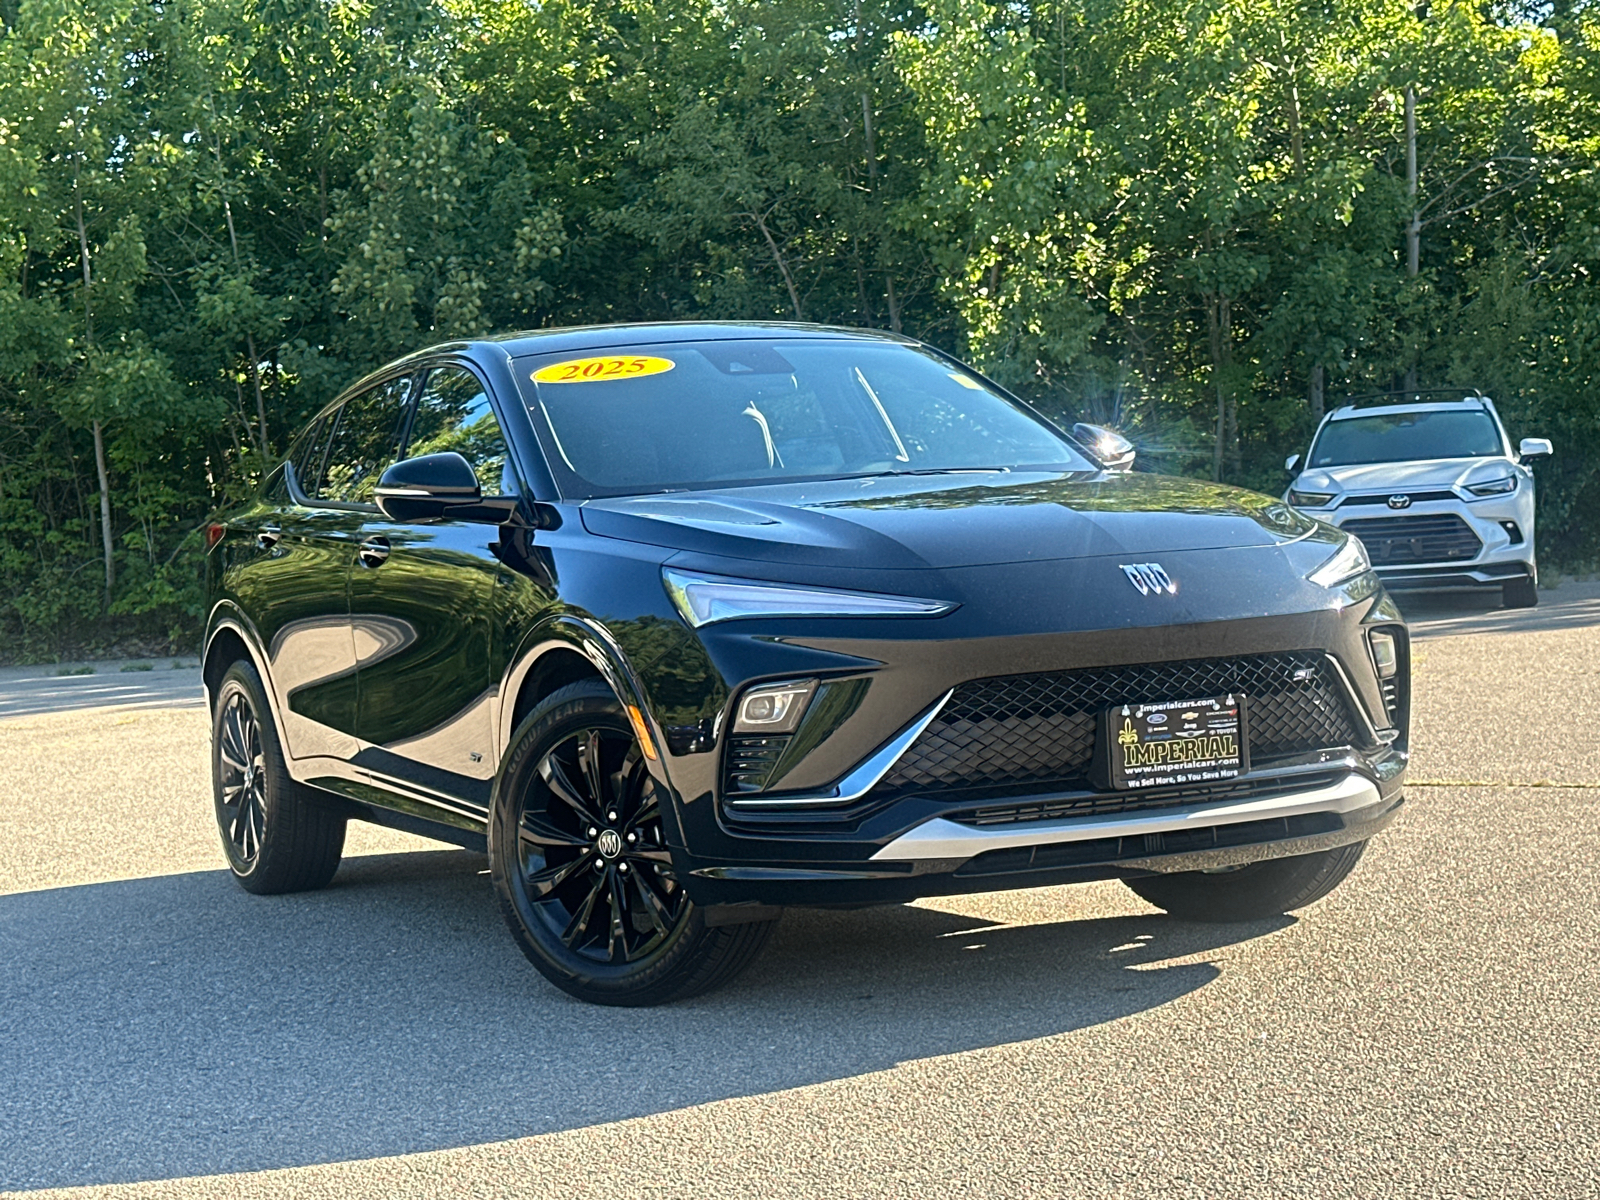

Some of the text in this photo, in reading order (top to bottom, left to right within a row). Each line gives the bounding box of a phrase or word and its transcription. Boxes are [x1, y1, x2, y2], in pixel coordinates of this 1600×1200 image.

[558, 359, 648, 380] 2025
[1140, 699, 1215, 713] Imperialcars.com
[1124, 735, 1239, 767] IMPERIAL
[1124, 758, 1239, 775] www.imperialcars.com
[1128, 780, 1140, 788] We
[1141, 778, 1155, 787] Sell
[1156, 776, 1176, 785] More,
[1203, 771, 1219, 779] Save
[1220, 769, 1238, 777] More
